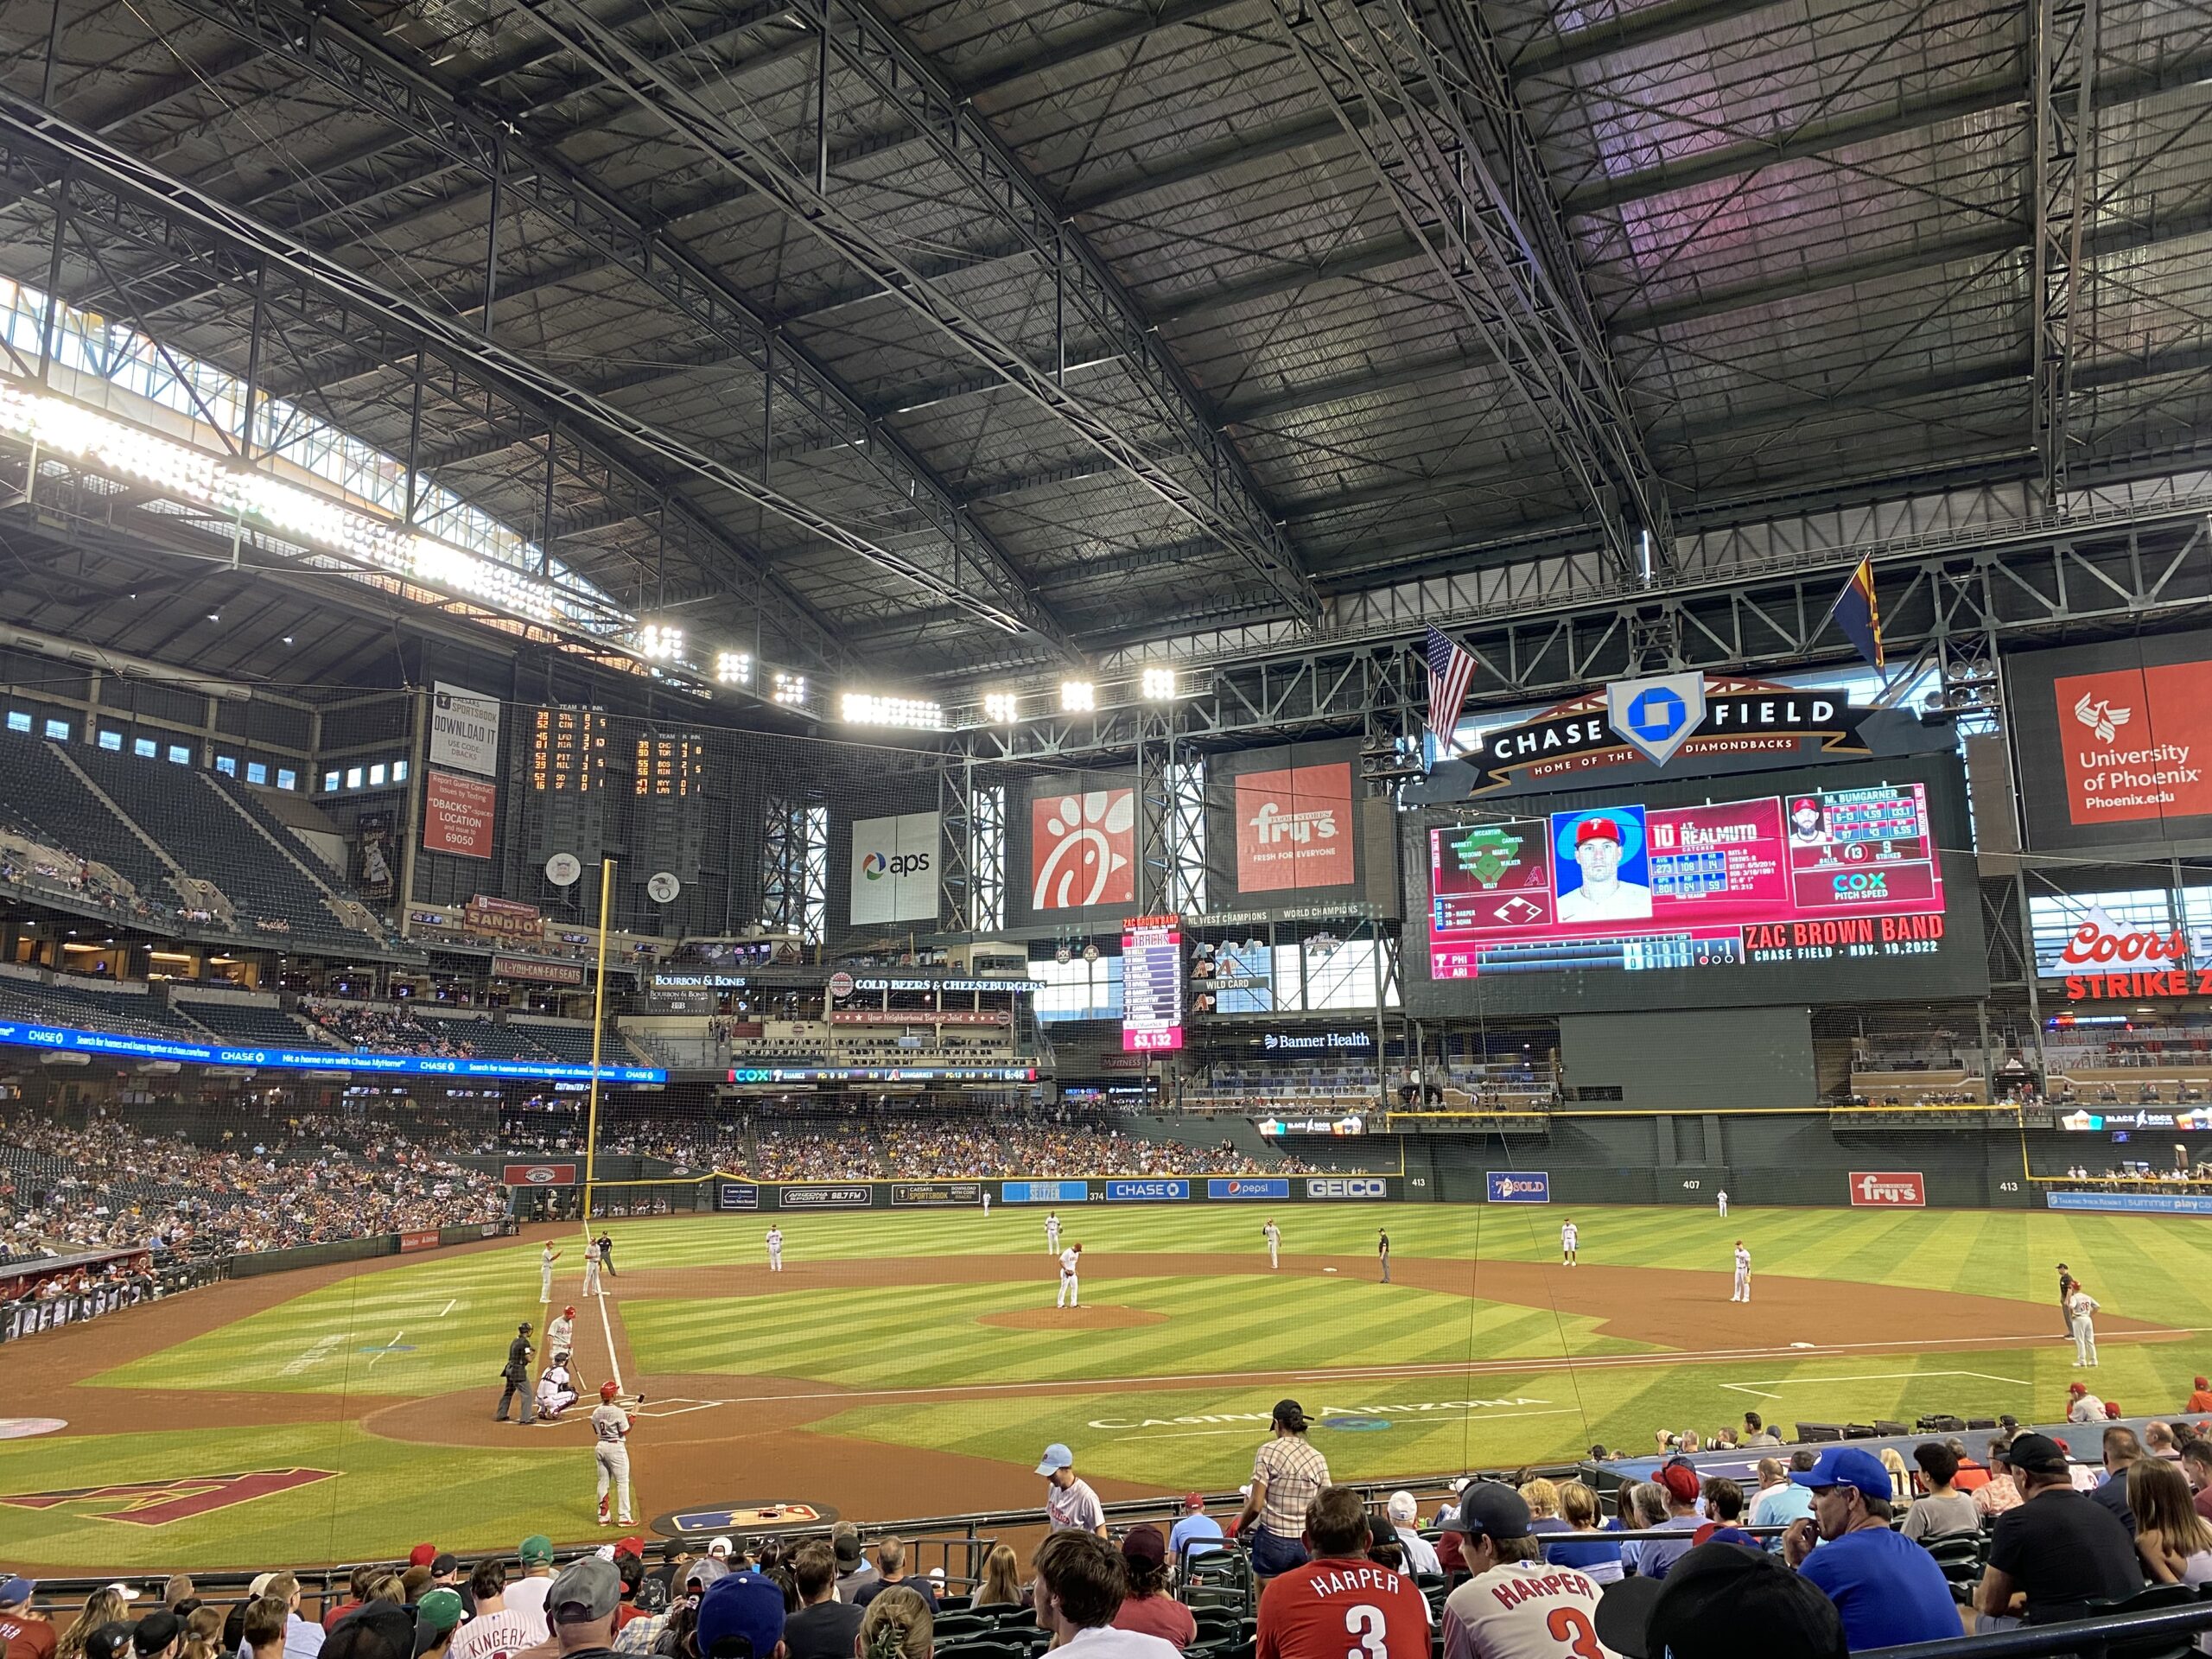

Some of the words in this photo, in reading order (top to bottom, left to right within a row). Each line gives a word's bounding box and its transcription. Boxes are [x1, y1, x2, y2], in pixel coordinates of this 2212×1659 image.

[452, 702, 498, 723] SPORTSBOOK
[435, 715, 484, 741] DOWNLOAD
[487, 728, 496, 745] IT
[1494, 720, 1602, 759] CHASE
[1715, 701, 1834, 726] FIELD
[448, 740, 460, 748] USE
[451, 748, 477, 760] DBACKS
[1535, 761, 1572, 776] HOME
[1581, 757, 1599, 766] OF
[1608, 751, 1633, 762] THE
[1685, 740, 1793, 753] DIAMONDBACKS
[2080, 744, 2190, 768] University
[433, 775, 452, 785] Report
[454, 779, 469, 790] Guest
[471, 784, 493, 794] Conduct
[537, 781, 544, 790] 16
[2083, 772, 2105, 791] of
[2110, 766, 2199, 791] Phoenix
[439, 785, 457, 795] Issues
[467, 791, 486, 803] Texting
[1825, 795, 1834, 804] M.
[1839, 789, 1897, 803] BUMGARNER
[2085, 791, 2175, 809] Phoenix.edu
[439, 811, 482, 828] LOCATION
[1836, 812, 1854, 822] 6-13
[1864, 810, 1882, 819] 4.59
[1891, 807, 1910, 817] 133.1
[1249, 803, 1336, 844] fry's
[1653, 824, 1675, 848] 10
[1681, 823, 1758, 846] REALMUTO
[1841, 830, 1852, 839] 97
[1869, 828, 1880, 837] 43
[1893, 825, 1911, 835] 6.55
[445, 833, 474, 846] 69050
[1253, 853, 1276, 862] FRESH
[1279, 851, 1294, 860] FOR
[1297, 848, 1336, 858] EVERYONE
[1851, 847, 1863, 858] 13
[889, 852, 930, 877] aps
[1681, 862, 1695, 872] 108
[1708, 861, 1718, 869] 14
[1684, 882, 1694, 892] 64
[1708, 881, 1720, 890] 59
[1833, 872, 1886, 892] COX
[1834, 891, 1858, 900] PITCH
[1860, 888, 1888, 899] SPEED
[1188, 917, 1198, 925] NL
[1198, 914, 1221, 925] WEST
[1222, 912, 1267, 923] CHAMPIONS
[1283, 908, 1310, 918] WORLD
[1312, 905, 1358, 917] CHAMPIONS
[469, 912, 543, 932] SANDLOT
[1123, 918, 1136, 927] ZAC
[1160, 915, 1179, 925] BAND
[1745, 924, 1787, 949] ZAC
[1794, 918, 1873, 946] BROWN
[1881, 914, 1943, 942] BAND
[2063, 921, 2188, 963] Coors
[1452, 955, 1467, 964] PHI
[1754, 949, 1793, 962] CHASE
[1797, 946, 1834, 959] FIELD
[1850, 944, 1879, 957] NOV.
[495, 961, 558, 978] ALL-YOU-CAN-EAT
[559, 968, 581, 981] SEATS
[1452, 968, 1467, 977] ARI
[655, 976, 701, 986] BOURBON
[702, 976, 712, 986] &
[715, 976, 746, 986] BONES
[855, 979, 888, 990] COLD
[891, 979, 931, 990] BEERS
[932, 981, 941, 990] &
[943, 979, 1046, 991] CHEESEBURGERS
[1206, 981, 1225, 990] WILD
[1228, 979, 1249, 988] CARD
[2065, 969, 2190, 1000] STRIKE
[867, 1013, 882, 1022] Your
[883, 1013, 924, 1022] Neighborhood
[925, 1013, 947, 1023] Burger
[948, 1013, 963, 1022] Joint
[29, 1030, 55, 1043] CHASE
[1134, 1033, 1172, 1048] $3,132
[1279, 1035, 1325, 1048] Banner
[1326, 1032, 1370, 1046] Health
[221, 1052, 255, 1062] CHASE
[283, 1054, 294, 1063] Hit
[300, 1056, 321, 1065] home
[351, 1058, 372, 1067] Chase
[420, 1061, 448, 1071] CHASE
[735, 1070, 768, 1081] COX
[1004, 1070, 1025, 1080] 6:46
[1242, 1183, 1268, 1196] pepsi
[1309, 1180, 1385, 1197] GEICO
[1412, 1178, 1426, 1187] 413
[1682, 1180, 1700, 1190] 407
[1857, 1175, 1917, 1203] fry's
[1999, 1180, 2018, 1192] 413
[831, 1192, 849, 1200] 98.7
[910, 1192, 949, 1200] SPORTSBOOK
[1029, 1188, 1060, 1201] SELTZER
[1089, 1192, 1104, 1201] 374
[1116, 1184, 1165, 1196] CHASE
[2128, 1198, 2171, 1207] summer
[2174, 1199, 2197, 1210] play
[1320, 1397, 1553, 1417] ARIZONA
[1310, 1568, 1399, 1598] HARPER
[1491, 1572, 1595, 1611] HARPER
[1345, 1604, 1387, 1659] 3
[1547, 1606, 1605, 1659] 3
[469, 1628, 526, 1658] KINGERY
